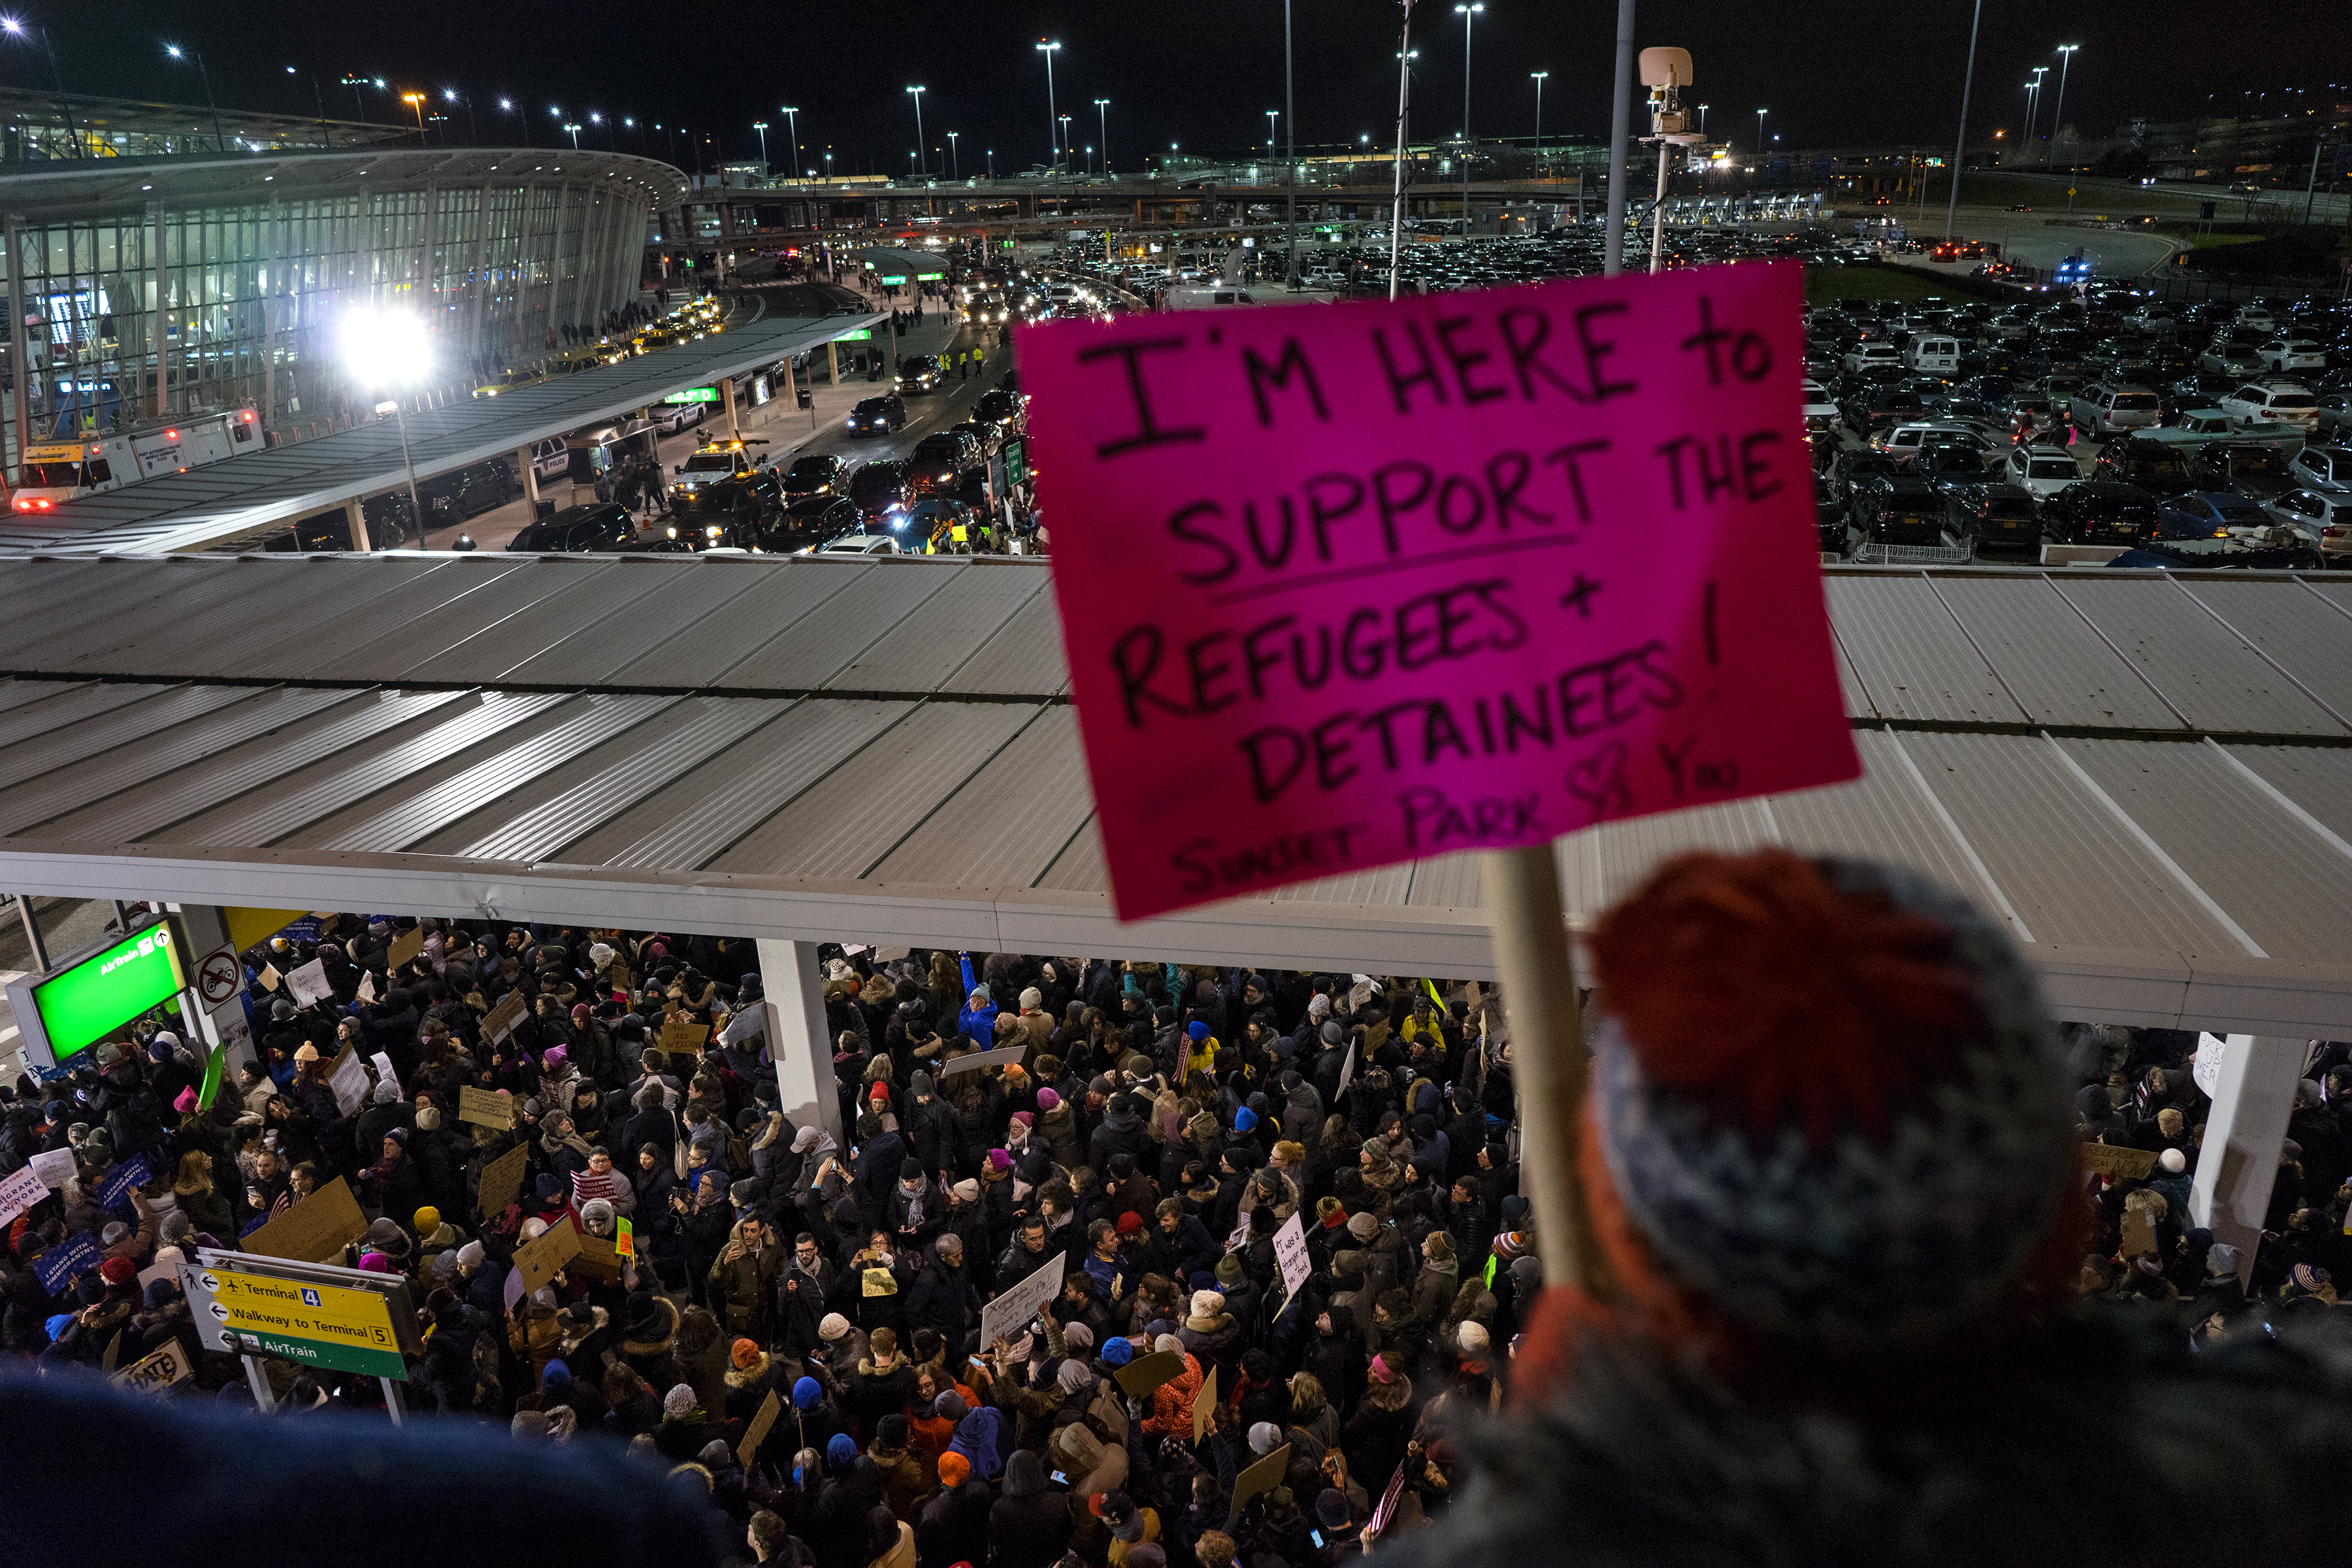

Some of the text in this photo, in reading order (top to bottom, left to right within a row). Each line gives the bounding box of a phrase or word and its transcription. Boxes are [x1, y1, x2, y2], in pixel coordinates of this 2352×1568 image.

[858, 331, 865, 339] C
[1077, 327, 1330, 457] I'M
[1370, 301, 1639, 416] HERE
[701, 389, 711, 400] D
[1008, 447, 1019, 459] Stretch
[549, 457, 565, 468] POLICE
[1167, 430, 1784, 587] SUPPORT THE
[1109, 576, 1529, 728] REFUGEES
[101, 949, 139, 975] AirTrain
[466, 1088, 504, 1100] DESCENDANT
[476, 1096, 511, 1107] IMMIGRANTS
[8, 1171, 24, 1183] YORK
[41, 1166, 71, 1177] EMPATHY
[2114, 1159, 2150, 1177] NOW
[104, 1166, 144, 1205] #IMMIGRANTNY
[106, 1177, 123, 1196] STAND
[124, 1164, 139, 1177] WITH
[15, 1183, 42, 1202] YORK
[1284, 1235, 1295, 1250] was
[46, 1245, 95, 1286] #IMMIGRANTNY
[49, 1256, 68, 1275] STAND
[69, 1242, 88, 1256] WITH
[1298, 1260, 1308, 1276] took
[865, 1273, 880, 1284] NO
[244, 1282, 319, 1306] Terminal 4
[865, 1281, 890, 1296] BAN
[987, 1286, 1028, 1318] Xenophobia
[988, 1281, 1058, 1333] TRAVEL BOYCOTT
[231, 1307, 386, 1342] Walkway to Terminal 5
[265, 1341, 318, 1358] AirTrain
